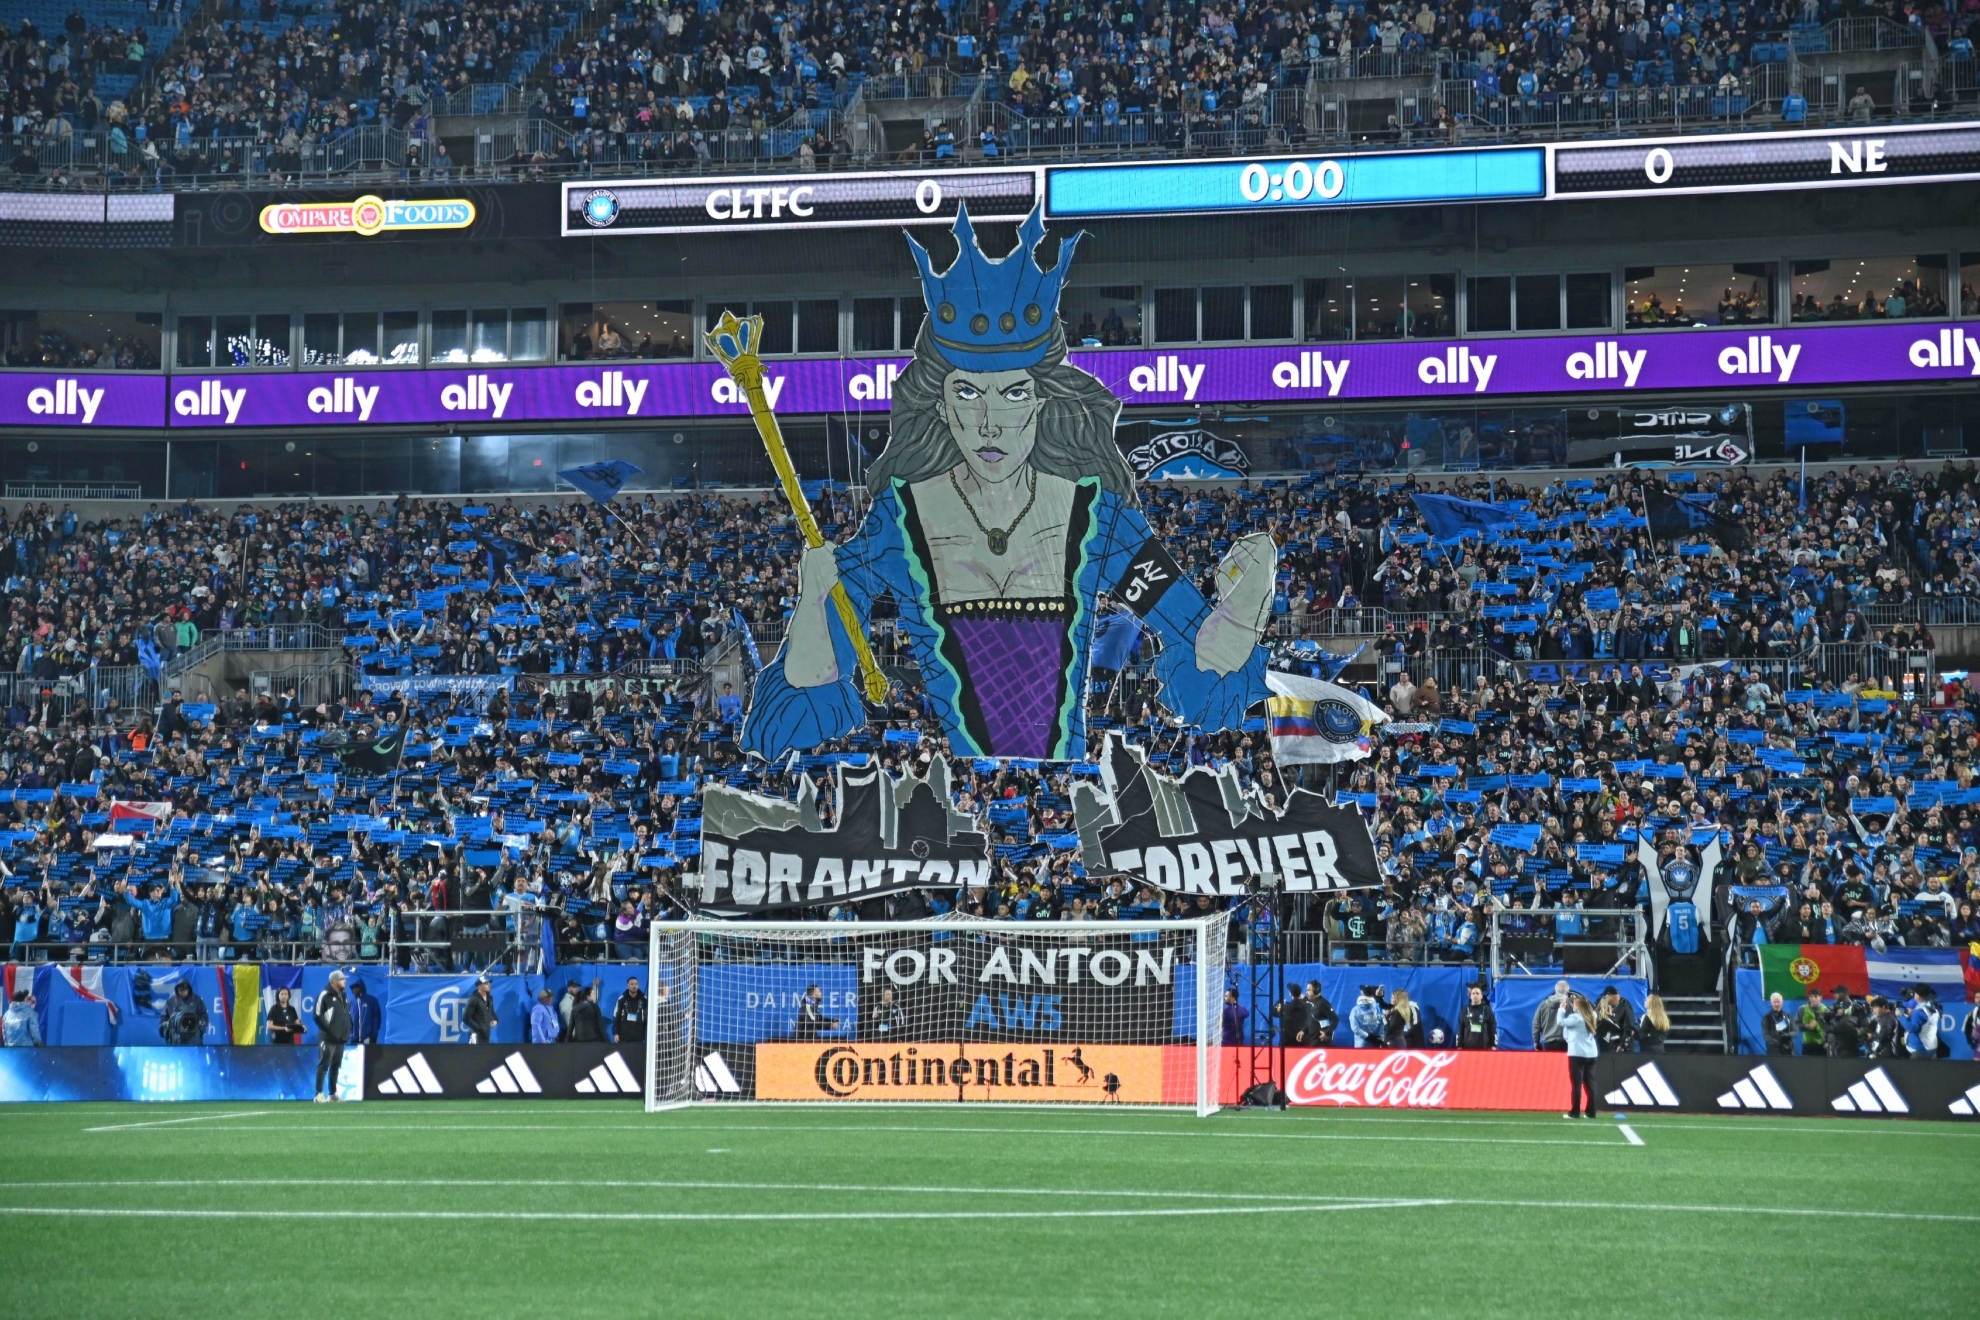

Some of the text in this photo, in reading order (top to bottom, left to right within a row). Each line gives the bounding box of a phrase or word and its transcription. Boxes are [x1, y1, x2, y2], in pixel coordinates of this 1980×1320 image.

[1239, 160, 1345, 203] 0:00
[1644, 139, 1889, 184] 0 NE
[269, 203, 351, 234] COMPARE
[385, 199, 465, 224] FOODS
[705, 180, 942, 222] CLTFC 0
[1129, 356, 1205, 400] ally
[1273, 352, 1350, 395] ally
[1418, 347, 1497, 391] ally
[1566, 342, 1646, 386] ally
[1719, 336, 1801, 381] ally
[28, 380, 104, 423] ally
[175, 381, 246, 423] ally
[308, 378, 379, 420] ally
[441, 375, 513, 418] ally
[576, 372, 648, 414] ally
[711, 375, 785, 411] ay
[848, 364, 898, 400] all
[1126, 576, 1149, 602] 5
[1133, 560, 1168, 582] AW
[368, 680, 410, 692] CROWN
[412, 678, 444, 690] TOWN
[702, 839, 802, 905] FOR
[1036, 910, 1051, 918] ally
[1678, 916, 1689, 930] 5
[862, 946, 1176, 987] FOR ANTON
[747, 992, 857, 1008] DAIMER
[965, 992, 1063, 1031] AW5
[815, 1046, 1056, 1098] Continental
[1286, 1048, 1458, 1107] Coca-Cola
